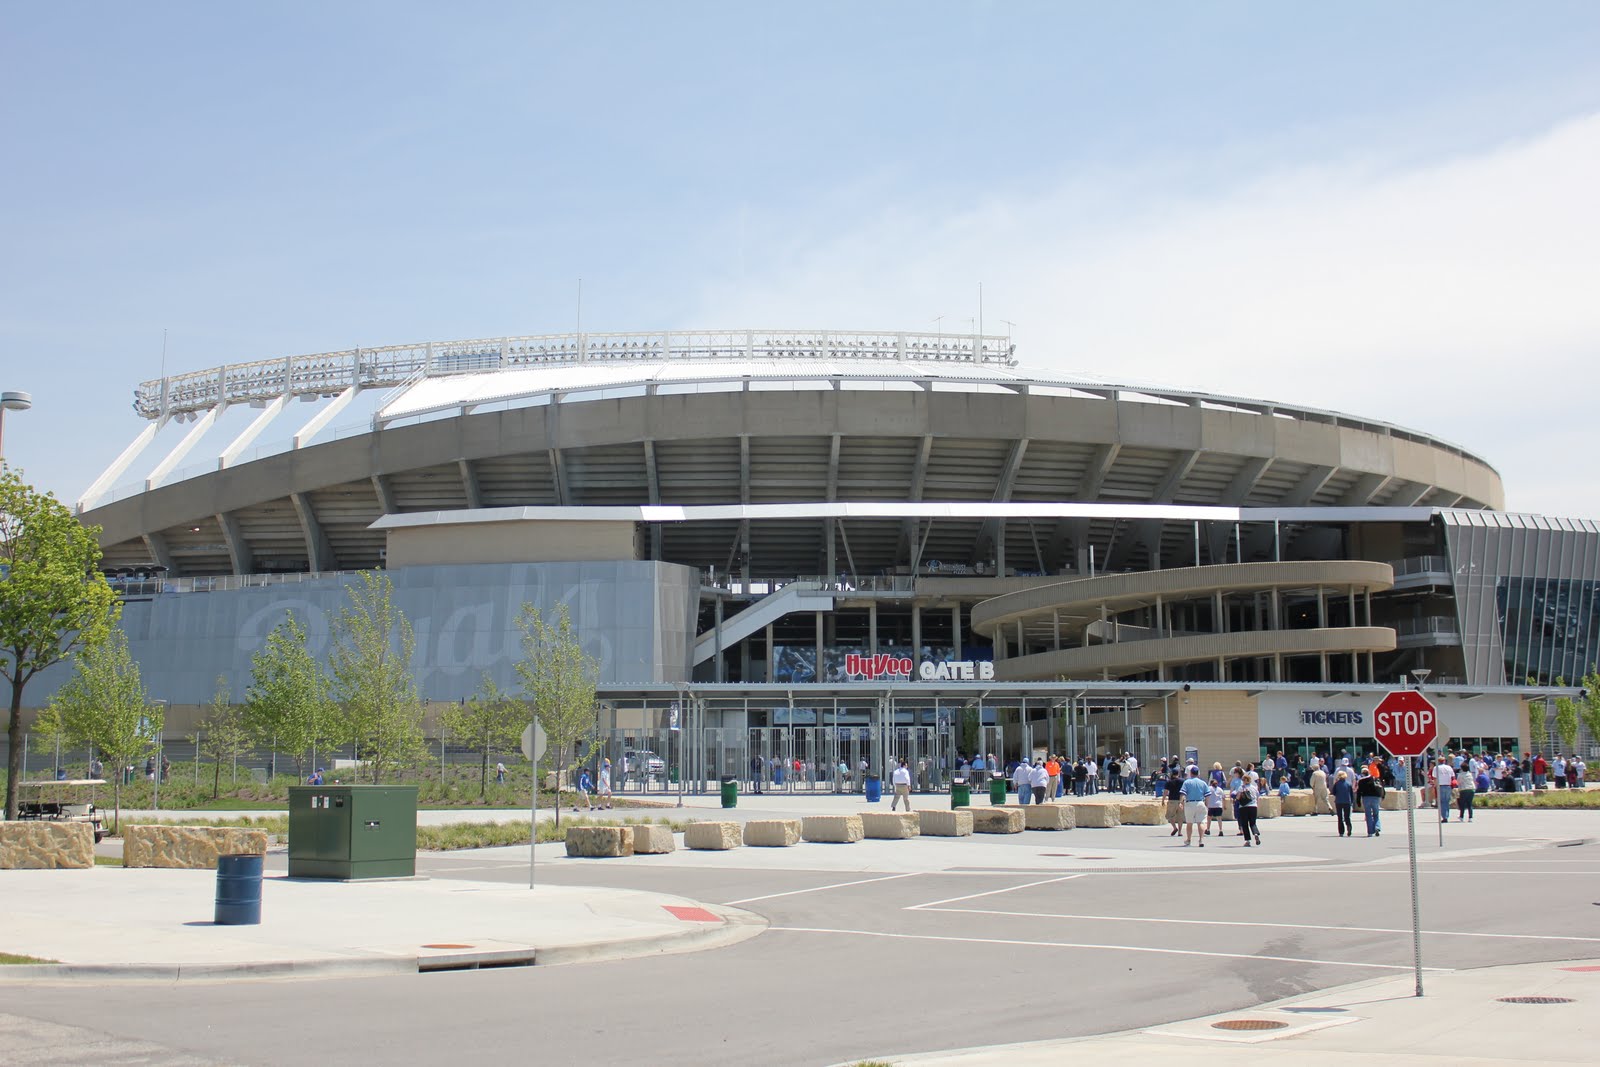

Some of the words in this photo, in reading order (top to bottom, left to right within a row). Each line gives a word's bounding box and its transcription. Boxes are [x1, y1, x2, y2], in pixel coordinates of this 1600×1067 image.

[920, 661, 975, 680] GATE
[979, 661, 995, 680] B
[1301, 711, 1363, 724] TICKETS
[1377, 710, 1433, 736] STOP
